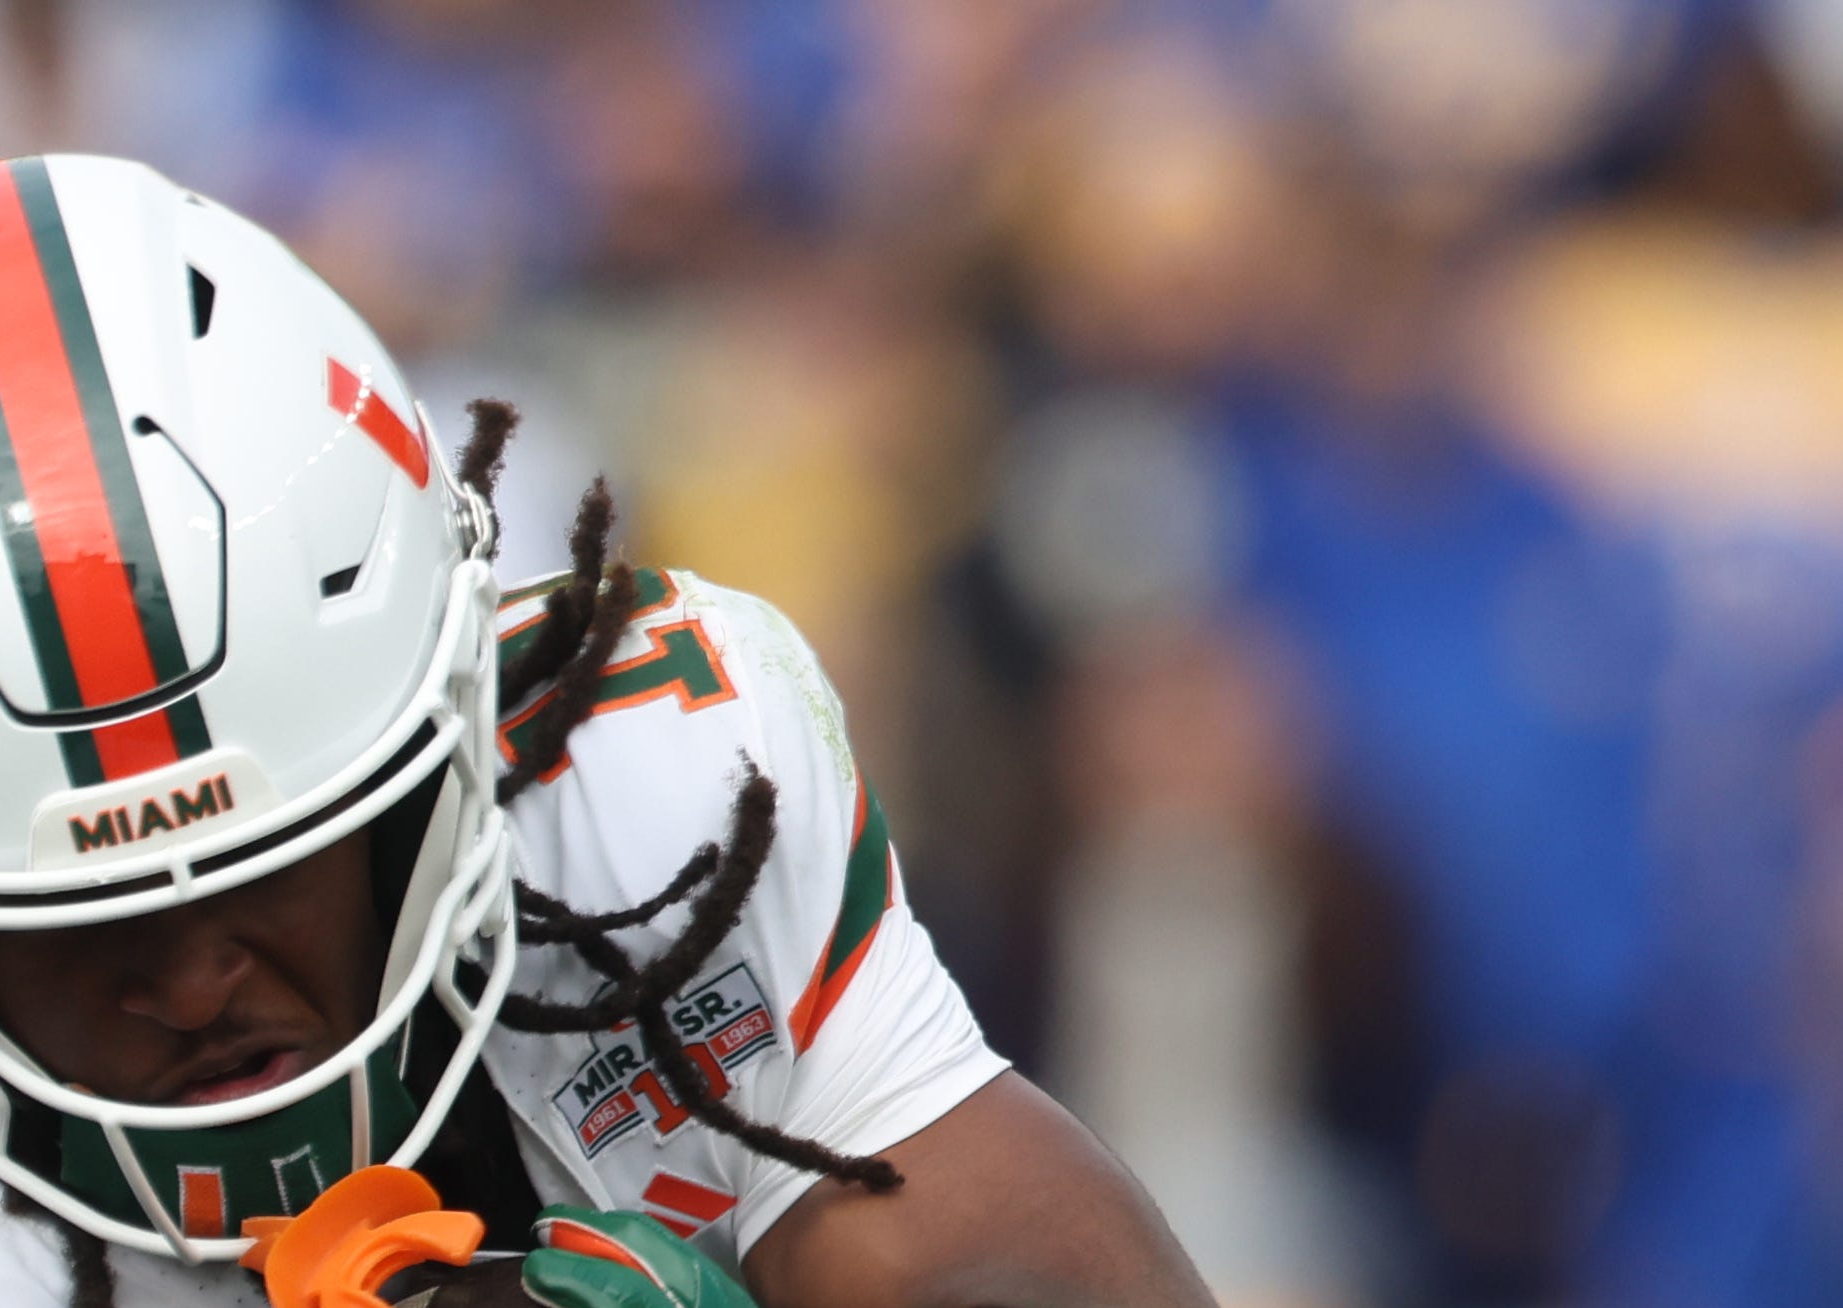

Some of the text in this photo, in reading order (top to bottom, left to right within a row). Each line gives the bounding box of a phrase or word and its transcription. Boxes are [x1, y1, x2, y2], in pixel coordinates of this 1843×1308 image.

[68, 771, 236, 853] MIAMI
[573, 991, 742, 1108] MIR SR.
